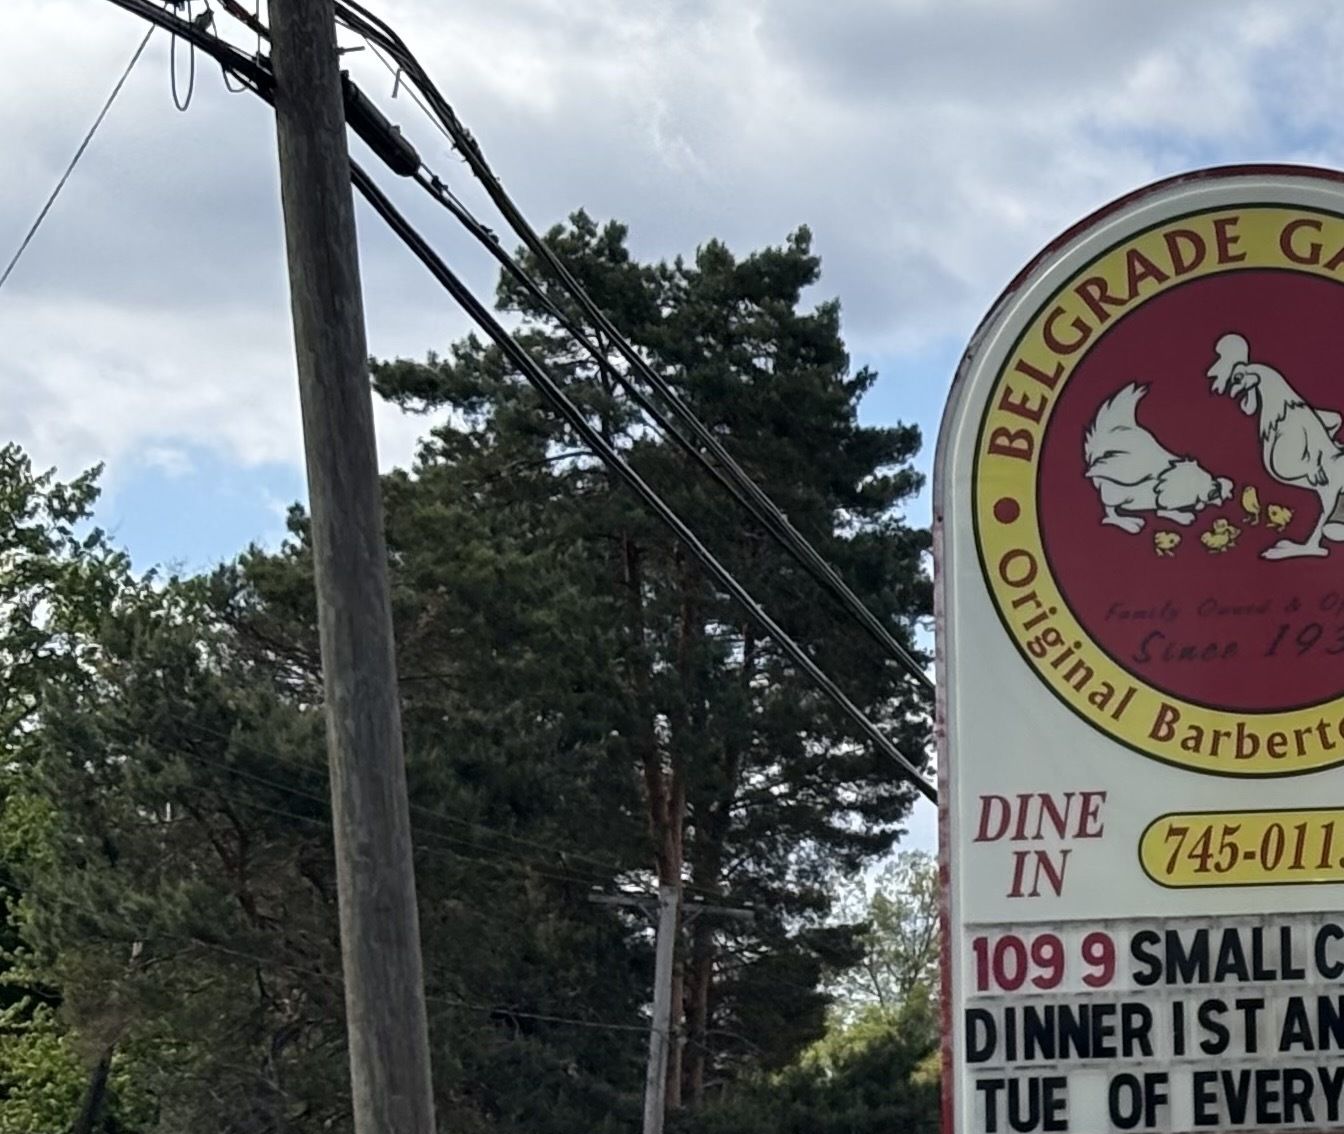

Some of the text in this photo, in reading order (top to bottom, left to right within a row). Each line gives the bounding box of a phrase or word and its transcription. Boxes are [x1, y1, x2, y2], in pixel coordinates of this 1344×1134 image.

[987, 216, 1248, 464] BELGRADE
[998, 547, 1139, 723] Original
[1132, 630, 1239, 664] Since
[973, 790, 1108, 844] DINE
[1006, 849, 1072, 898] IN
[1129, 925, 1306, 987] SMALL
[964, 1002, 1154, 1064] DINNER
[975, 1075, 1069, 1134] TUE
[1107, 1072, 1169, 1130] OF
